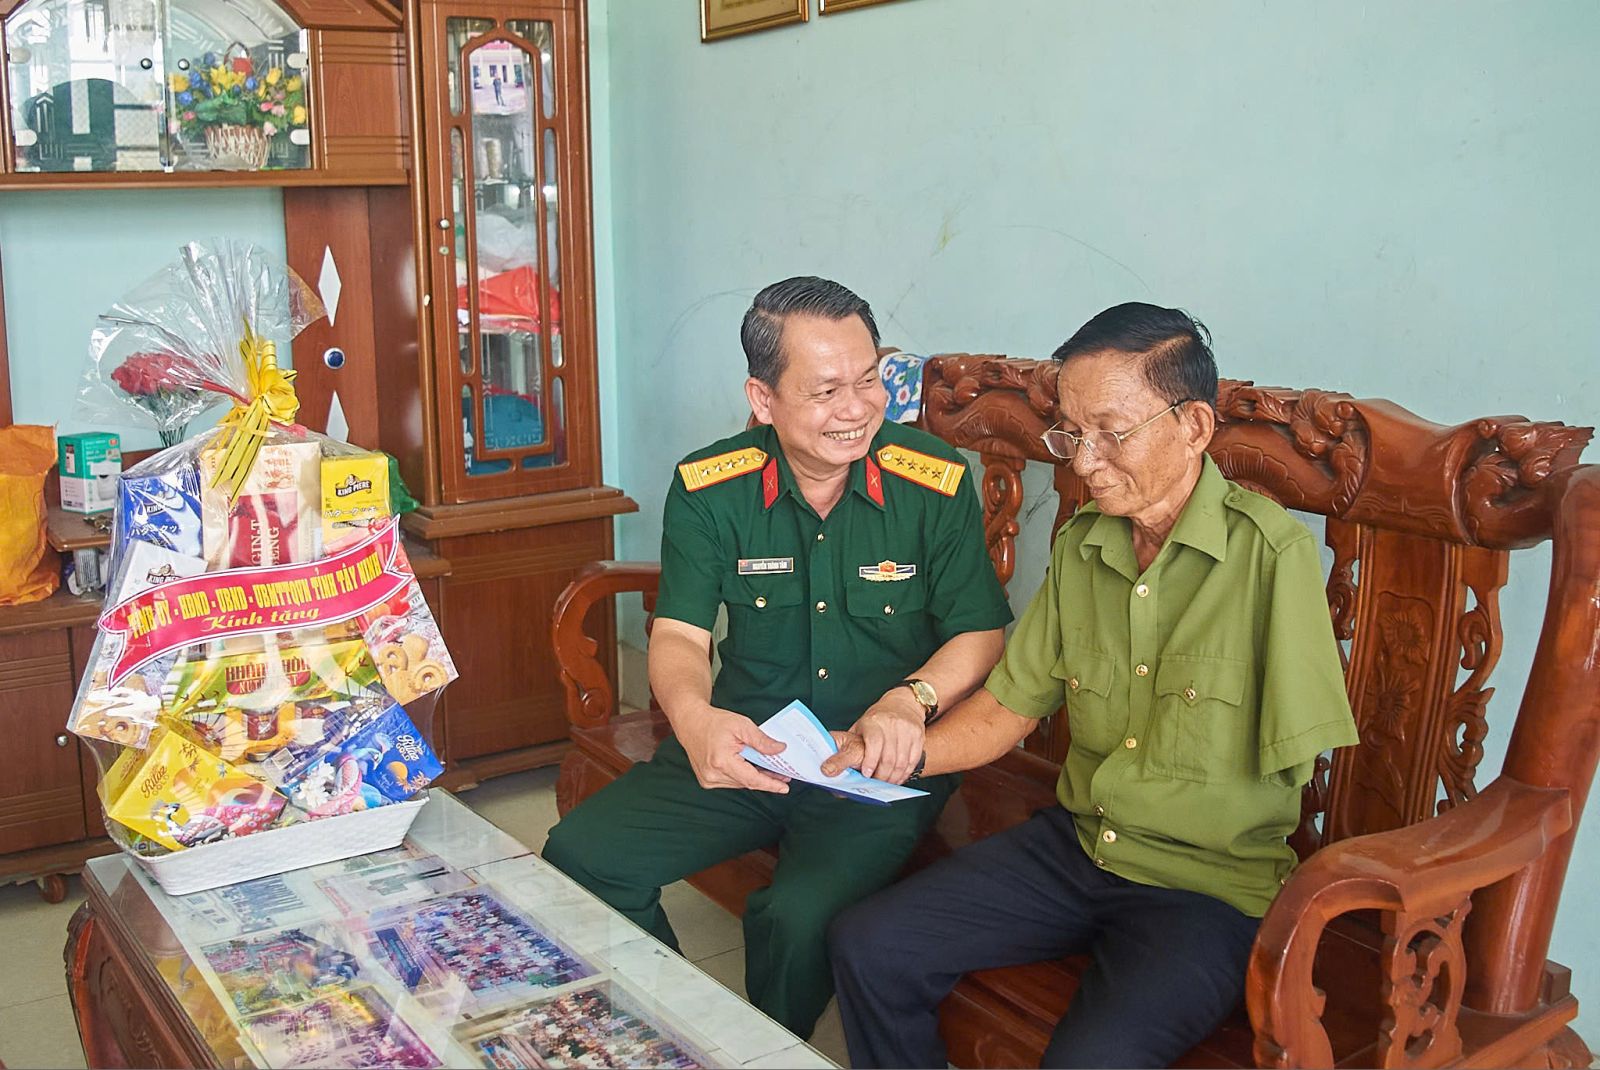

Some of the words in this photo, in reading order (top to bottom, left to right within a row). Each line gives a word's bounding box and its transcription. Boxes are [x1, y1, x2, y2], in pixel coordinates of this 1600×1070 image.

[337, 486, 353, 496] KING
[215, 586, 248, 614] UBND
[310, 567, 338, 600] TỈNH
[336, 562, 358, 594] TÂY
[356, 551, 382, 586] NINH
[201, 610, 263, 632] Kính
[270, 607, 319, 625] tặng
[396, 742, 411, 761] GOLD
